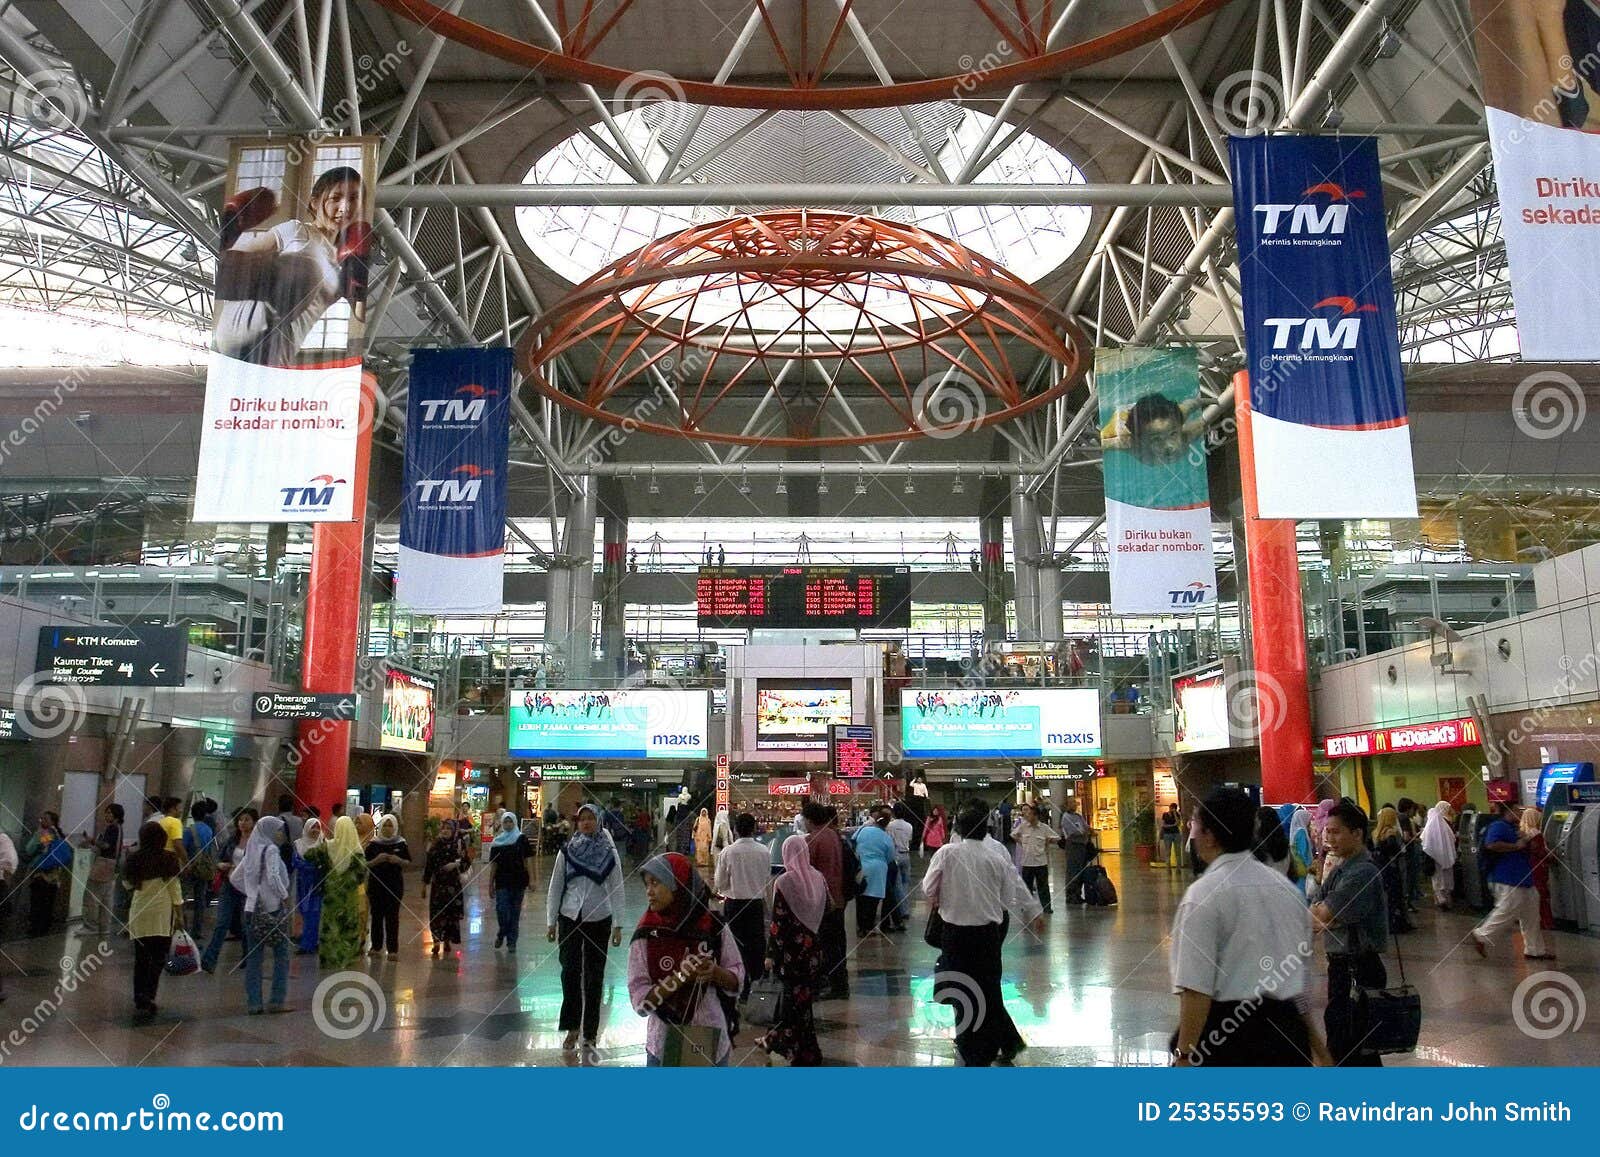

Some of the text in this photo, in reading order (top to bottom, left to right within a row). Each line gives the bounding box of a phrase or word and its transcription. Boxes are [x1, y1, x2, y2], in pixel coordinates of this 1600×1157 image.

[1253, 204, 1349, 234] TM
[1261, 238, 1342, 247] Merintis kemungkinan
[1263, 318, 1361, 349] TM
[1271, 353, 1353, 363] Merintis kemungkinan
[229, 397, 328, 412] Diriku bukan
[420, 399, 486, 421] TM
[214, 415, 345, 430] sekadar nombor.
[280, 487, 335, 505] TM
[415, 479, 482, 501] TM
[1125, 529, 1192, 540] Diriku bukan
[1117, 542, 1205, 552] sekadar nombor.
[1168, 590, 1205, 603] TM
[76, 637, 140, 646] KTM Komuter
[53, 657, 114, 666] Kaunter Tiket
[274, 694, 316, 704] Penerangan
[653, 734, 700, 745] maxis
[1047, 732, 1094, 744] maxis
